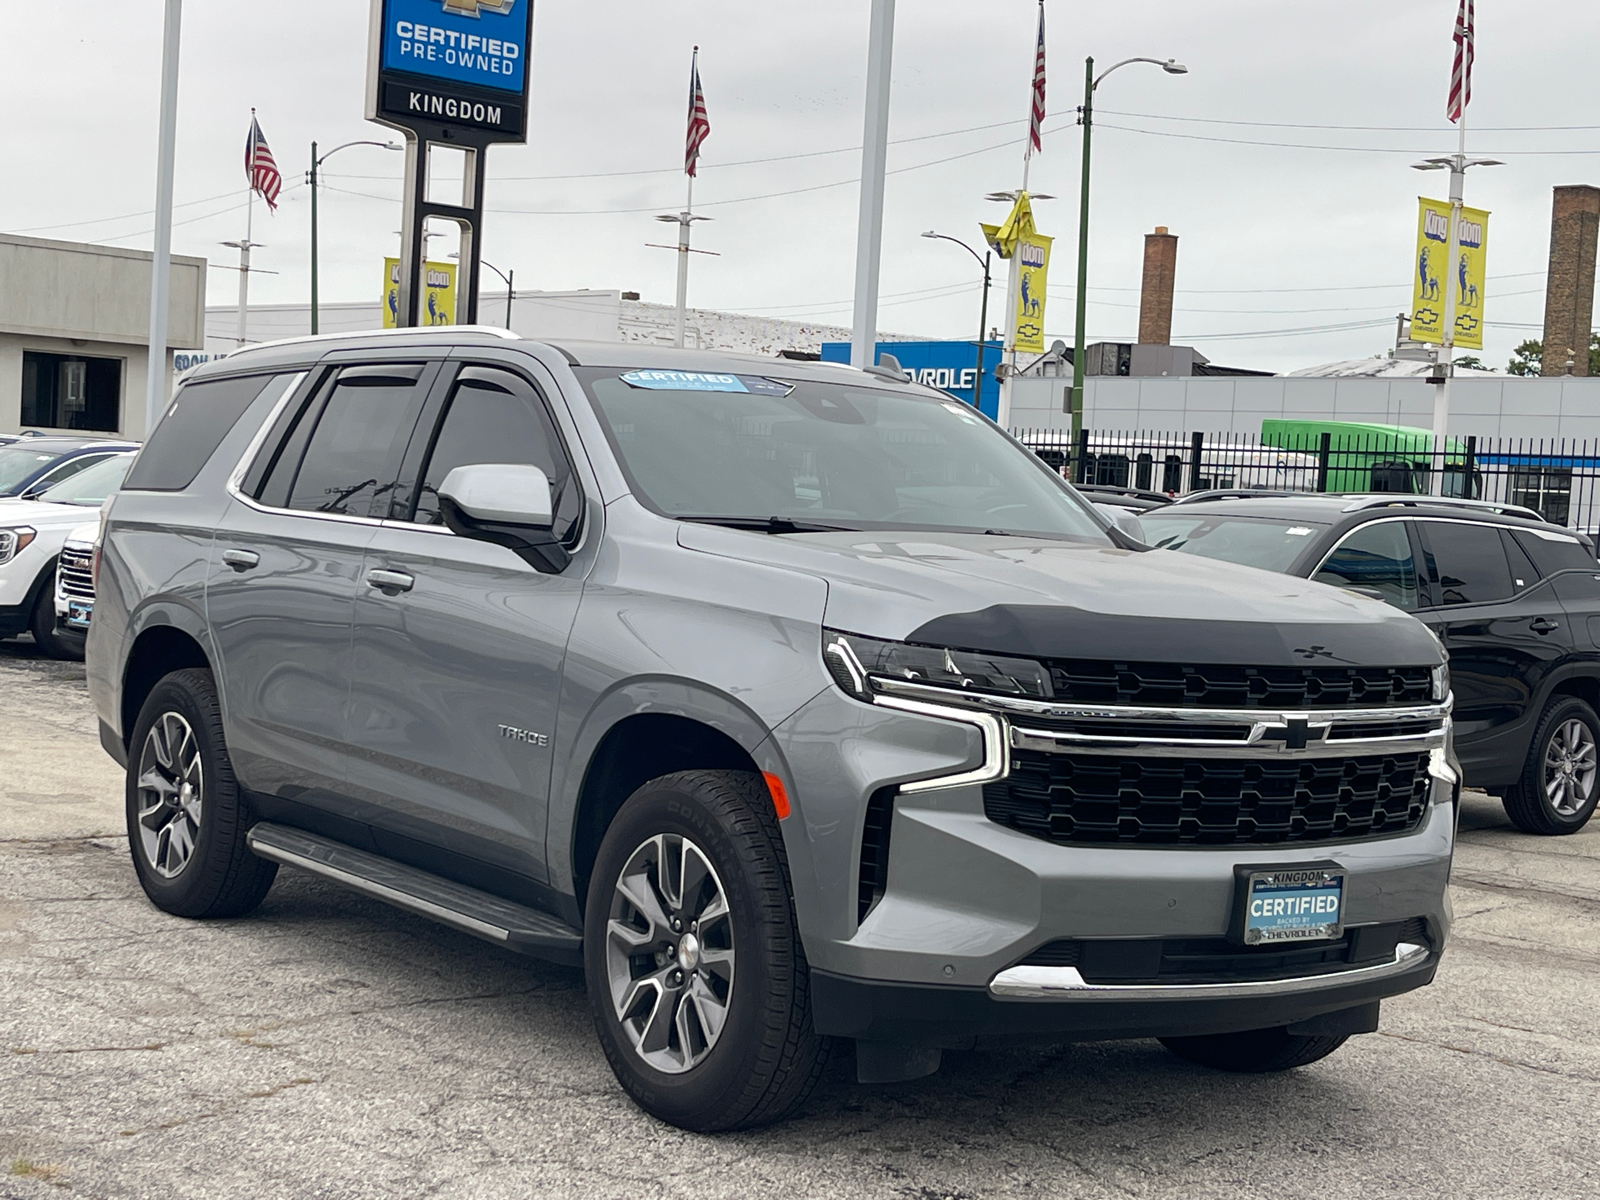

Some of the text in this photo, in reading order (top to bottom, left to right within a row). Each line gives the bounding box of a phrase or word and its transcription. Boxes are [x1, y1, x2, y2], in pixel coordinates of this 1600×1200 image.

[396, 21, 519, 59] CERTIFIED
[401, 40, 513, 76] PRE-OWNED
[409, 91, 501, 125] KINGDOM
[1424, 209, 1449, 242] King
[1459, 217, 1482, 247] dom
[1022, 241, 1044, 267] dom
[427, 268, 450, 287] dom
[624, 371, 734, 385] CERTIFIED
[498, 724, 548, 747] TAHOE
[1273, 871, 1325, 884] KINGDOM
[1251, 896, 1338, 917] CERTIFIED
[1268, 928, 1319, 939] CHEVROLET
